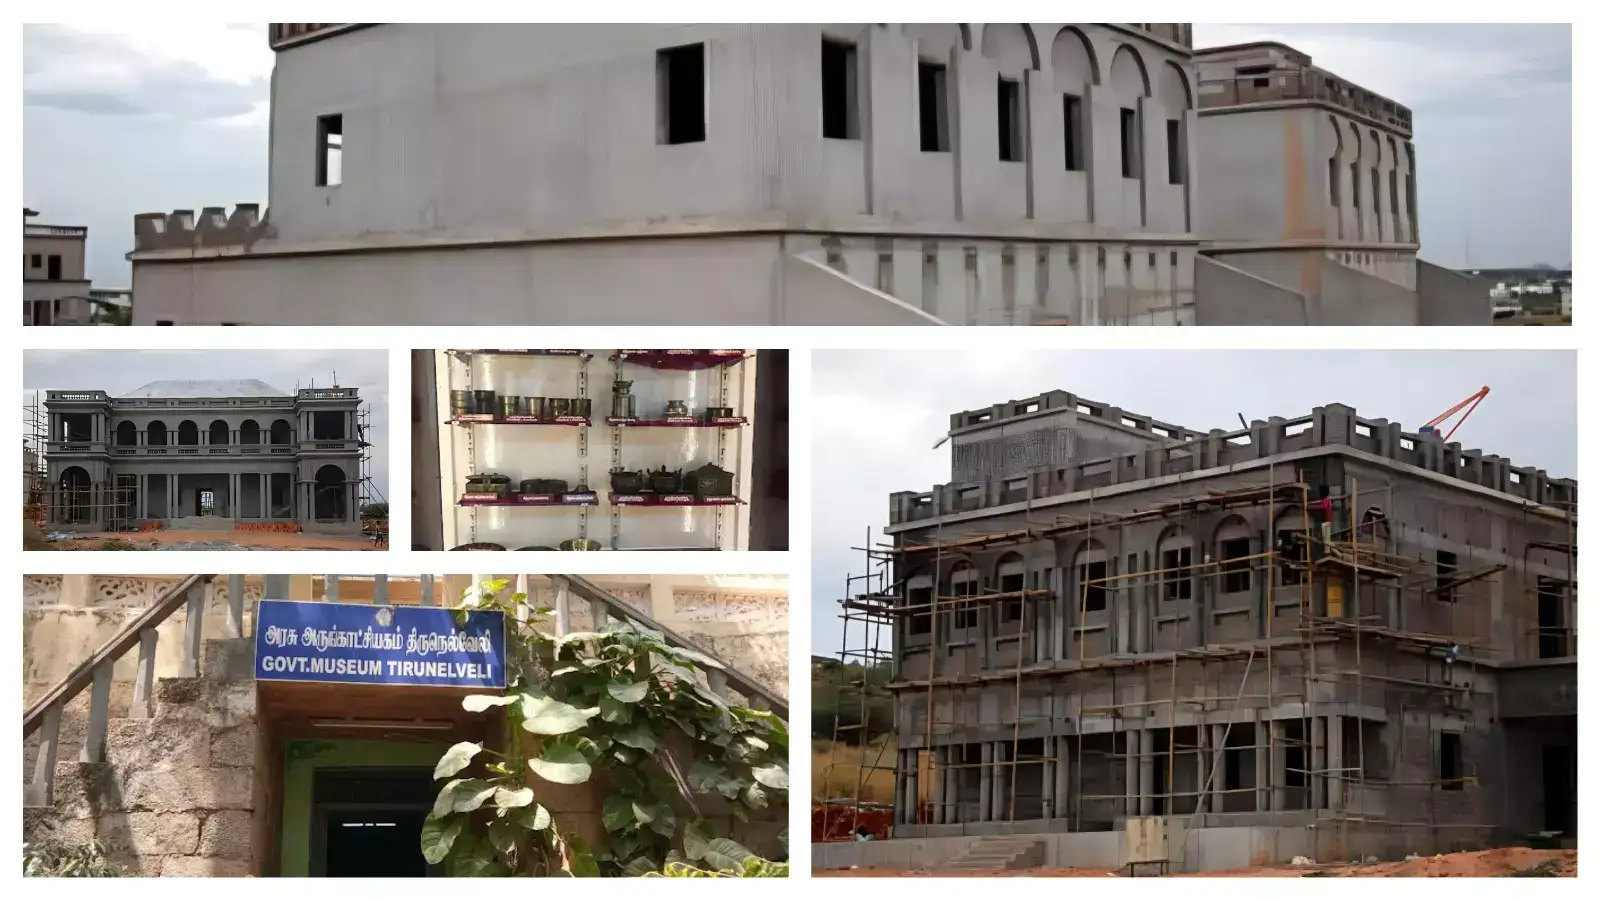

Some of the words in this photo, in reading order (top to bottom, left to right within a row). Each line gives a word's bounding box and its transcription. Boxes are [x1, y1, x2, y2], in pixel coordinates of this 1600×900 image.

[265, 625, 298, 648] அரசு
[301, 624, 404, 653] அருங்காட்சியகம்
[406, 626, 492, 657] திருநெல்வேலி
[262, 656, 382, 676] GOVT.MUSEUM
[387, 660, 492, 679] TIRUNELVELI
